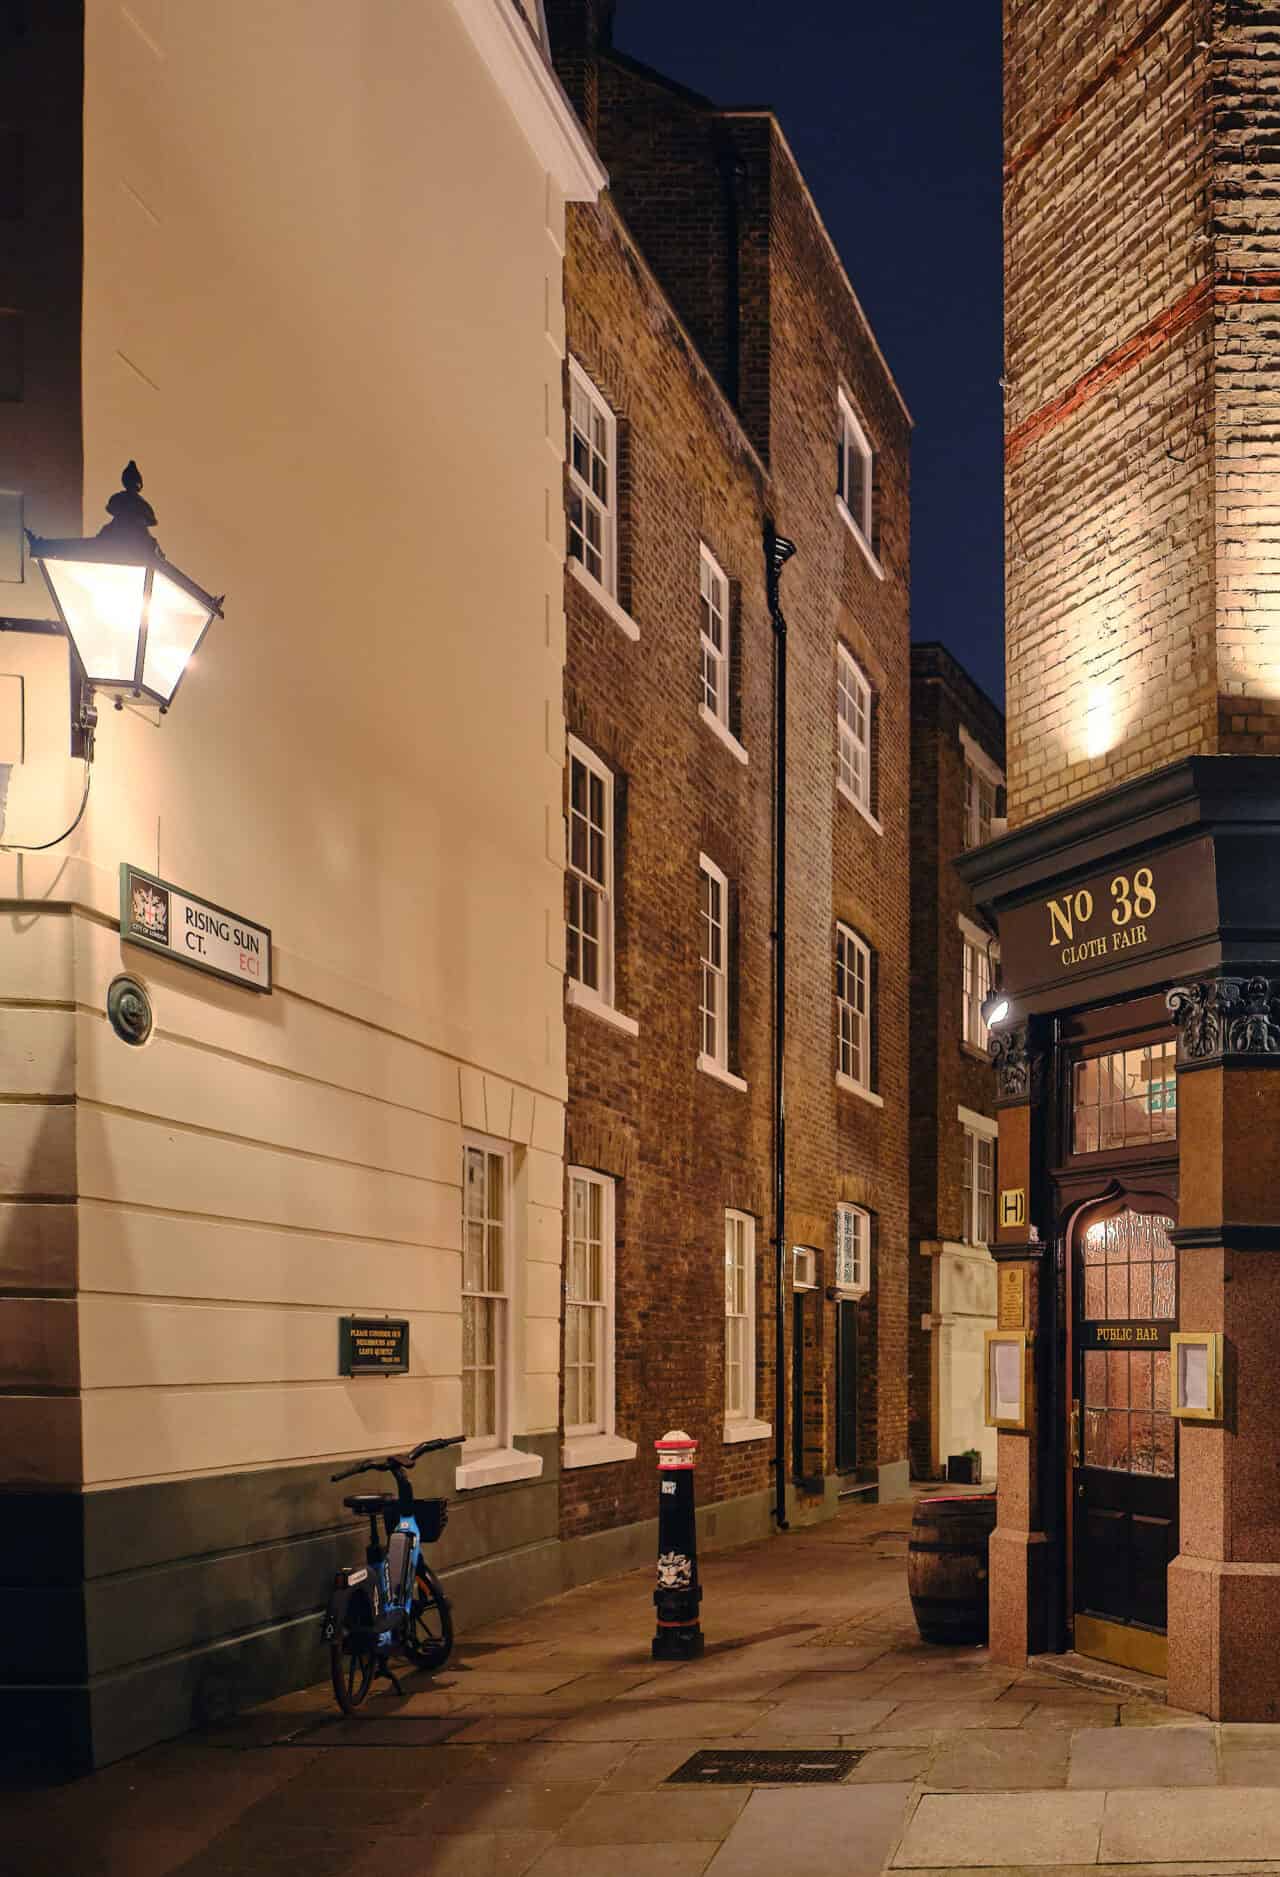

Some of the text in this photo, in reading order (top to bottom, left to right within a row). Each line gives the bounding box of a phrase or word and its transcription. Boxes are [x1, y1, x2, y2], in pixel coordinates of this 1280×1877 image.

[1110, 868, 1156, 925] 38
[185, 907, 259, 954] RISING SUN
[185, 931, 207, 955] CT.
[1061, 924, 1148, 966] CLOTH FAIR
[239, 953, 260, 977] EC1
[1096, 1327, 1159, 1341] PUBLIC BAR
